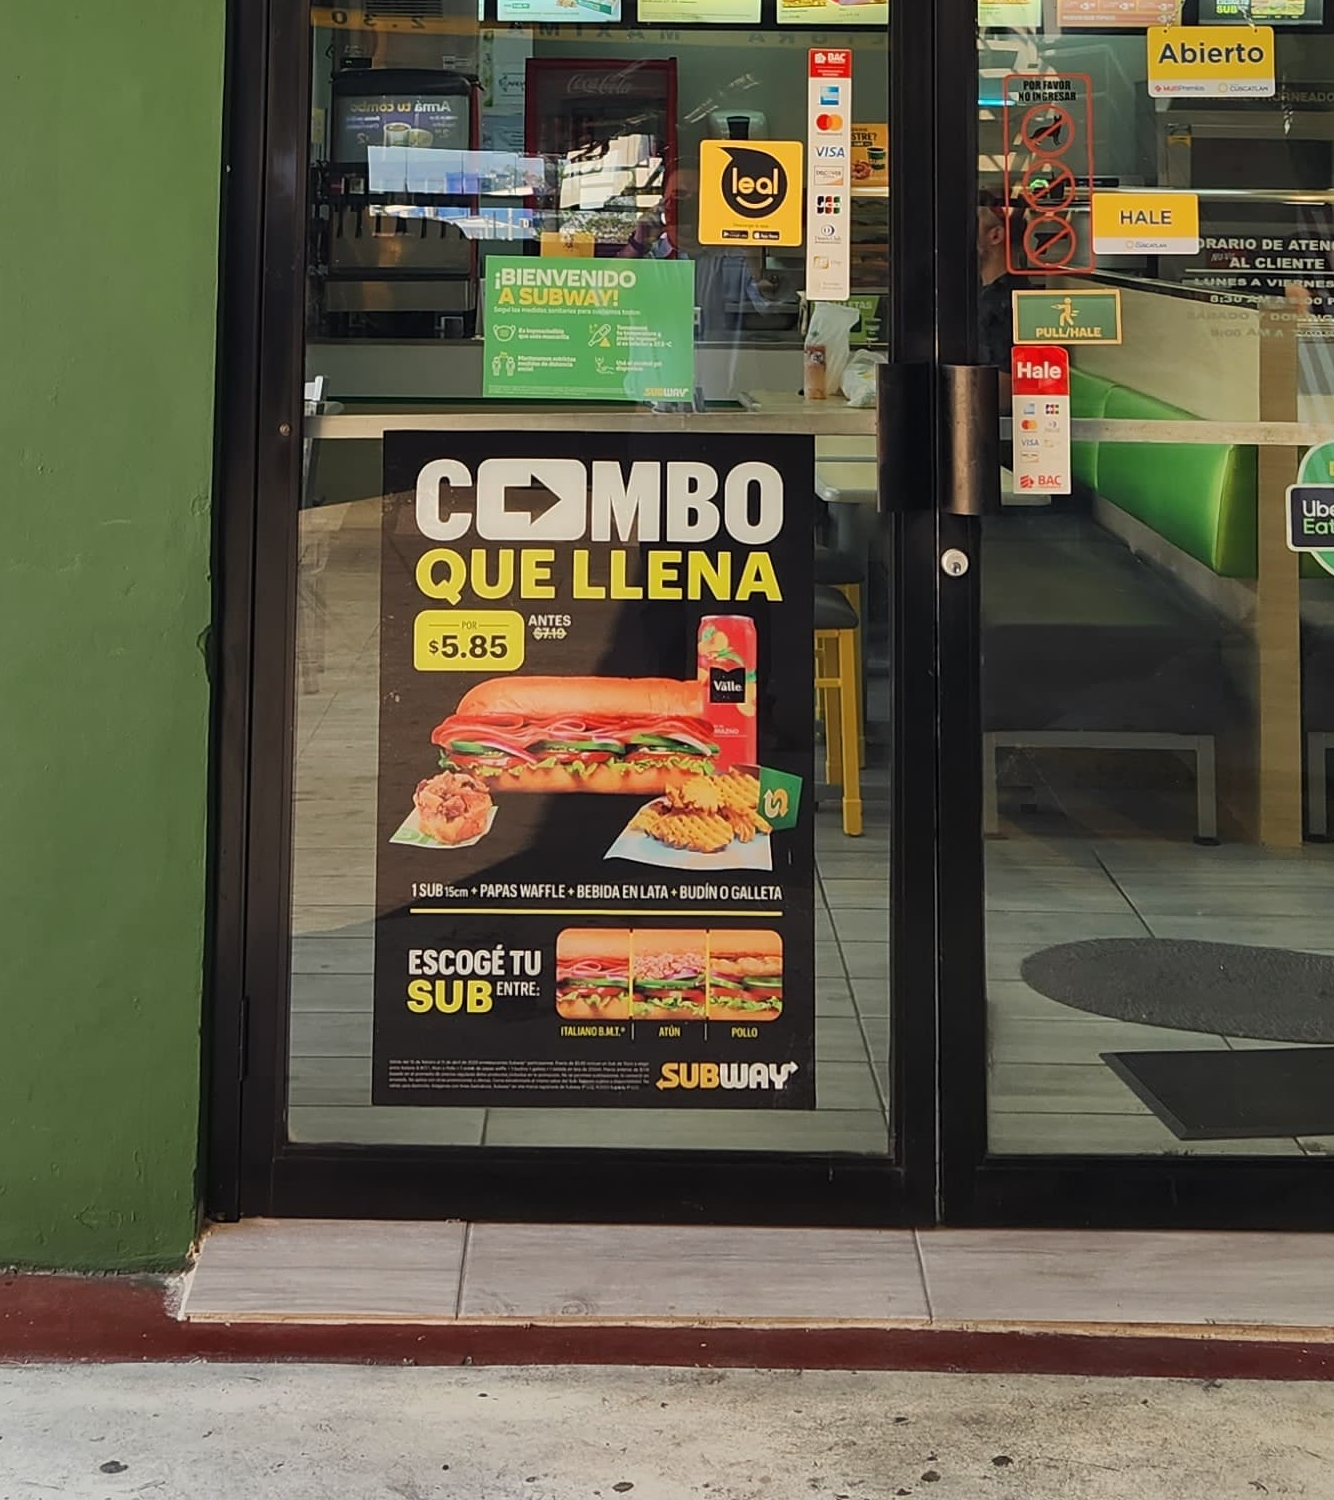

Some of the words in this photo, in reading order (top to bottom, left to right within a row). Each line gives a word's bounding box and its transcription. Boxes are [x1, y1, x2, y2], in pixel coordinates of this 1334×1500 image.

[827, 52, 846, 61] BAC
[1158, 42, 1265, 64] Abierto
[1023, 80, 1041, 90] POR
[1043, 80, 1071, 90] FAVOR
[1018, 91, 1031, 101] NO
[1032, 91, 1077, 101] INGRESAR
[815, 146, 846, 158] VISA
[732, 167, 779, 195] leal
[1119, 210, 1172, 225] HALE
[1261, 239, 1283, 251] DE
[1229, 257, 1251, 268] AL
[1255, 257, 1325, 269] CLIENTE
[494, 268, 637, 290] ¡BIENVENIDO
[1194, 277, 1247, 287] LUNES
[1250, 278, 1262, 287] A
[1266, 279, 1334, 289] VIERNES
[498, 287, 516, 305] A
[519, 287, 619, 308] SUBWAY!
[1035, 327, 1102, 338] PULL/HALE
[1016, 361, 1062, 379] Hale
[642, 387, 689, 397] SUBWAY
[1021, 438, 1040, 446] VISA
[1037, 475, 1062, 485] BAC
[415, 548, 556, 605] QUE
[573, 549, 783, 602] LLENA
[461, 620, 477, 630] POR
[528, 614, 572, 627] ANTES
[428, 634, 509, 659] $5.85
[411, 883, 417, 897] 1
[418, 882, 443, 898] SUB
[444, 886, 468, 898] 15cm
[479, 883, 517, 898] PAPAS
[520, 883, 566, 899] WAFFLE
[576, 884, 620, 899] BEBIDA
[622, 885, 638, 899] EN
[640, 885, 668, 899] LATA
[679, 882, 717, 899] BUDÍN
[719, 885, 729, 899] O
[731, 885, 783, 900] GALLETA
[408, 943, 505, 976] ESCOGÉ
[510, 950, 542, 976] TU
[407, 978, 493, 1013] SUB
[496, 980, 540, 997] ENTRE:
[560, 1026, 598, 1037] ITALIANO
[658, 1025, 681, 1037] ATÚN
[731, 1026, 758, 1038] POLLO
[655, 1061, 800, 1091] SUBWAY
